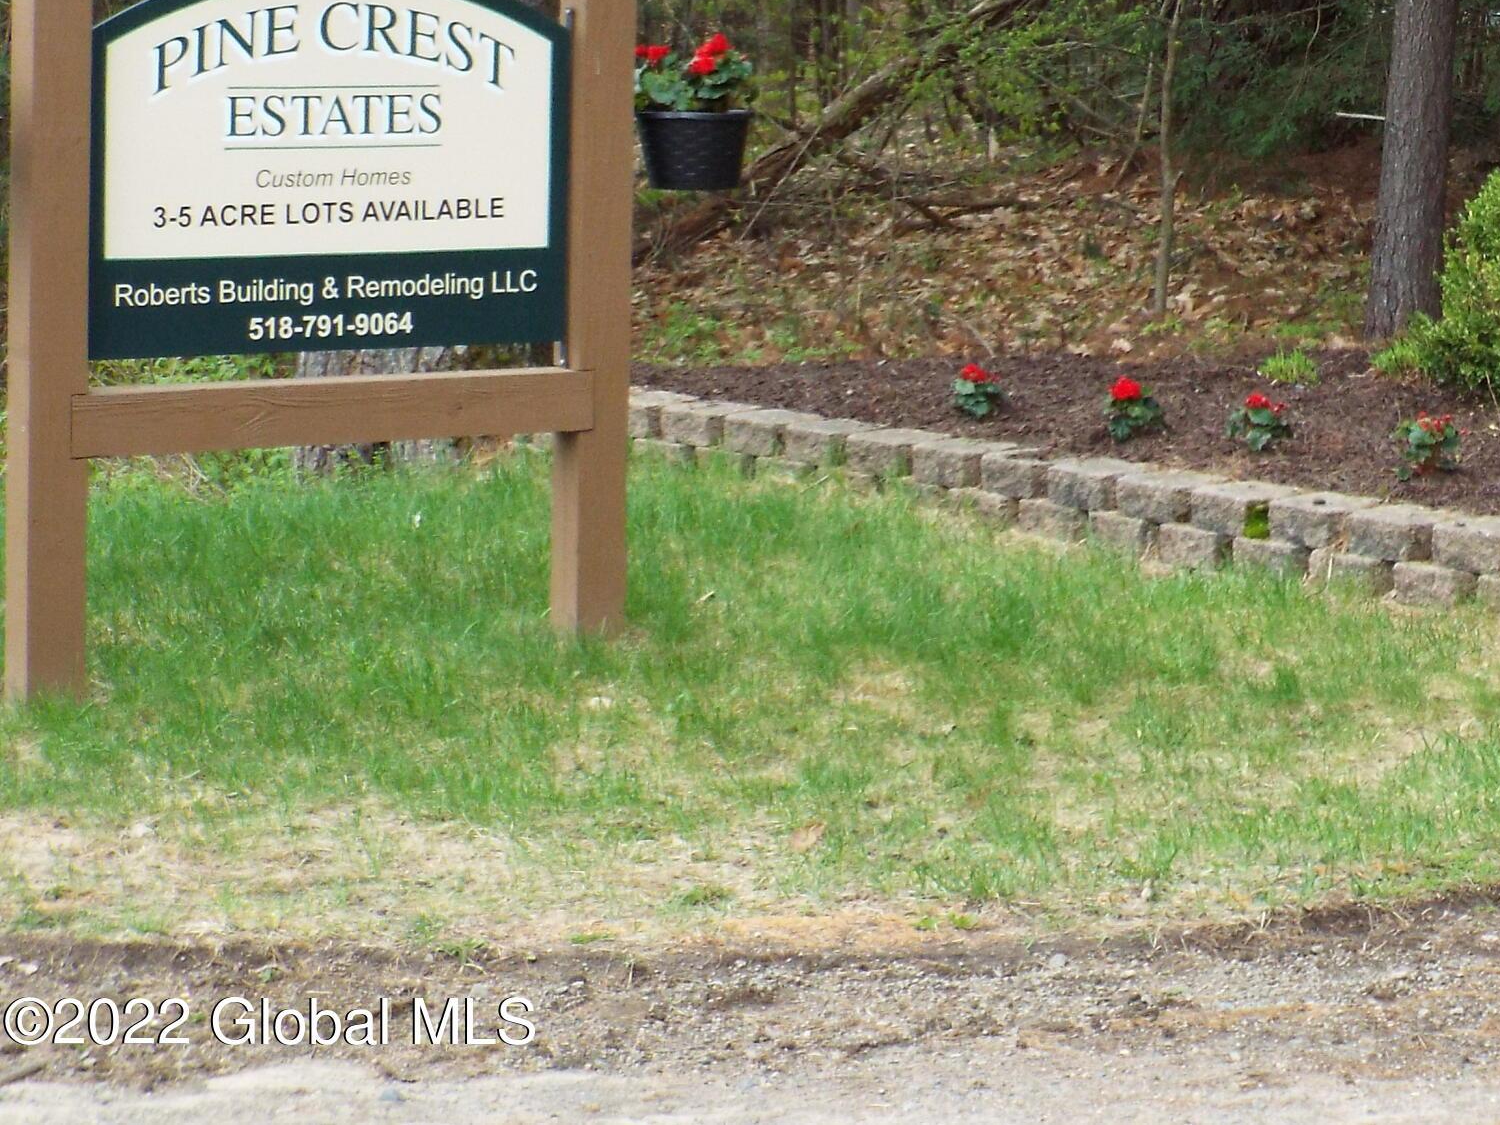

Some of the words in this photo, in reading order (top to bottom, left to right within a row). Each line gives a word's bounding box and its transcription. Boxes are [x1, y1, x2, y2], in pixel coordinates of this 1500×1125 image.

[152, 4, 301, 95] PINE
[319, 2, 515, 89] CREST
[226, 93, 442, 138] ESTATES
[255, 169, 333, 189] Custom
[341, 168, 411, 187] Homes
[153, 206, 192, 228] 3-5
[200, 204, 275, 226] ACRE
[286, 202, 354, 224] LOTS
[362, 197, 505, 222] AVAILABLE
[114, 282, 210, 307] Roberts
[219, 278, 314, 305] Building
[322, 278, 339, 299] &
[347, 272, 484, 301] Remodeling
[491, 269, 537, 294] LLC
[249, 312, 413, 340] 518-791-9064
